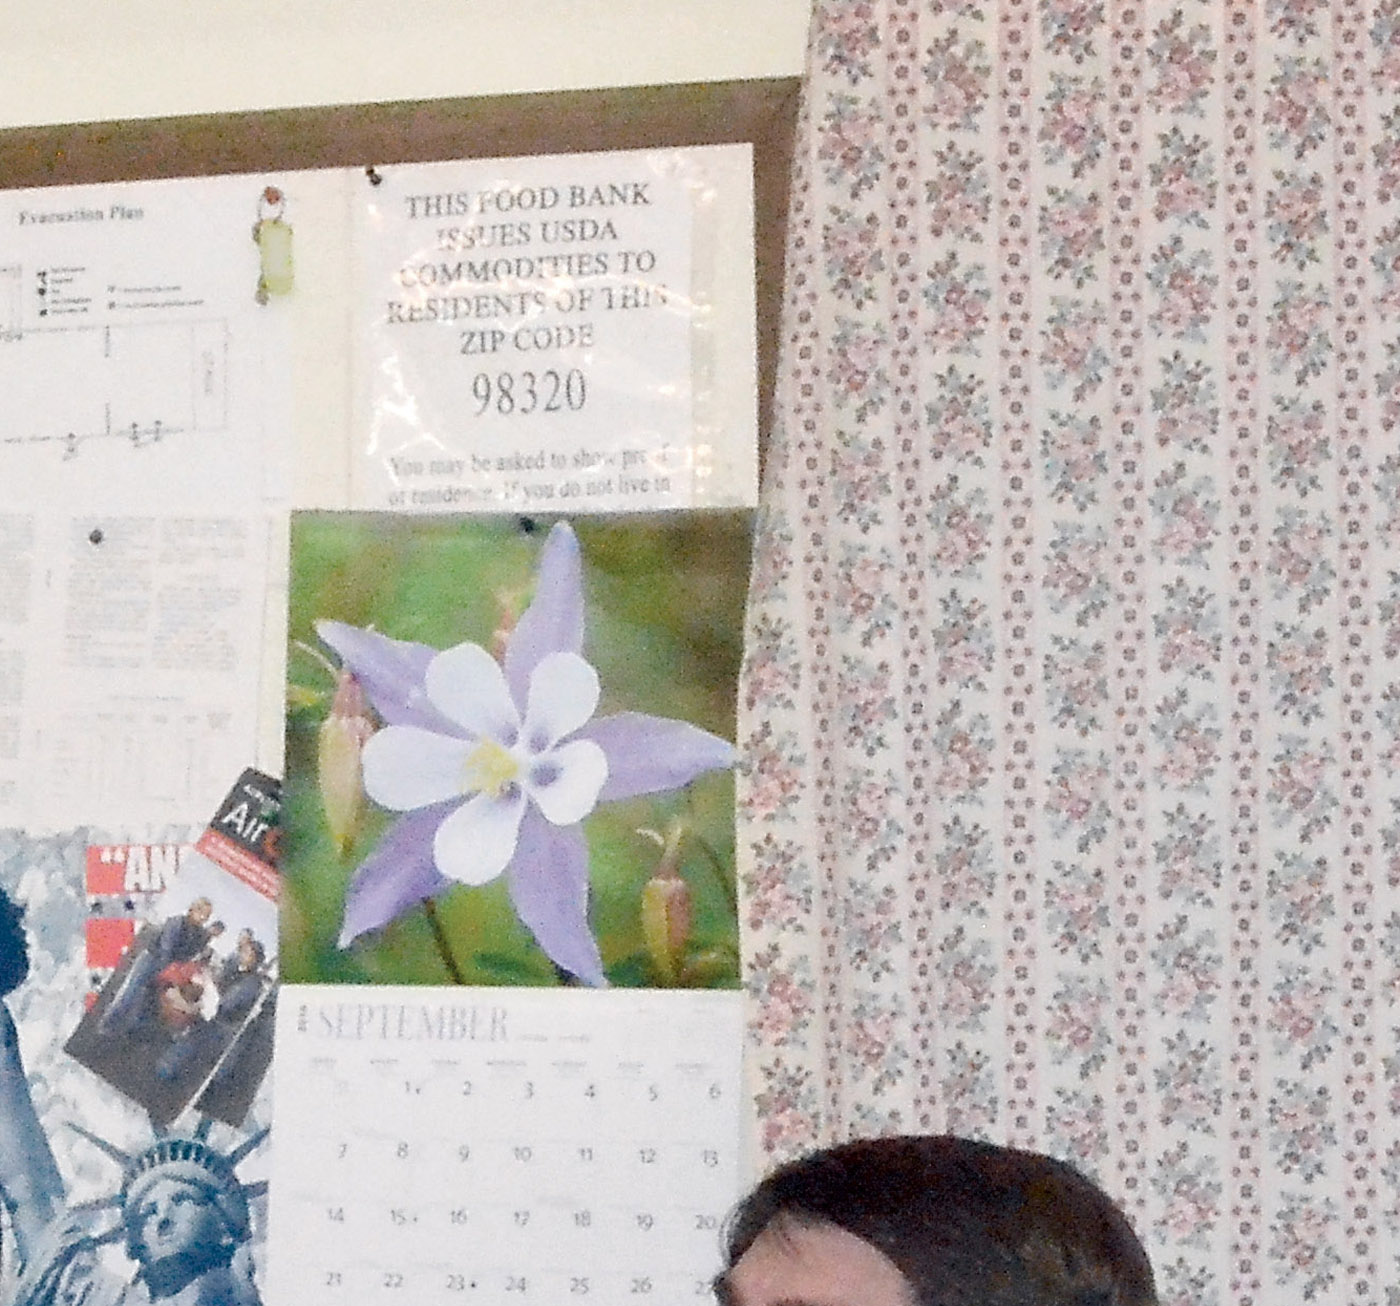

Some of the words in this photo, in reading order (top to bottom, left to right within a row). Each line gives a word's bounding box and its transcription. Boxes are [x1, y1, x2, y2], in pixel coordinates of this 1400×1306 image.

[18, 207, 104, 225] Evacuation
[110, 204, 145, 222] Plan
[405, 191, 468, 219] THIS
[477, 185, 560, 214] FOOD
[569, 182, 653, 208] BANK
[437, 222, 531, 251] ISSUES
[541, 218, 618, 244] USDA
[400, 250, 609, 288] COMMODITIES
[617, 249, 656, 274] TO
[387, 291, 546, 325] RESIDENTS
[555, 288, 597, 314] OF
[600, 284, 668, 312] THIS
[460, 330, 506, 356] ZIP
[514, 323, 596, 352] CODE
[472, 368, 587, 417] 98320
[471, 453, 491, 471] be
[496, 450, 545, 470] asked
[559, 481, 581, 499] do
[618, 474, 650, 496] live
[319, 1003, 509, 1041] SEPTEMBER
[405, 1081, 413, 1095] 1
[462, 1080, 473, 1096] 2
[525, 1081, 535, 1099] 3
[584, 1083, 597, 1099] 4
[709, 1083, 721, 1100] 6
[338, 1143, 348, 1159] 7
[396, 1141, 409, 1159] 8
[458, 1145, 470, 1162] 9
[512, 1146, 533, 1162] 10
[578, 1147, 594, 1161] 11
[638, 1148, 657, 1164] 12
[327, 1207, 345, 1223] 14
[390, 1209, 407, 1226] 15
[450, 1207, 468, 1224] 16
[573, 1209, 592, 1228] 18
[635, 1214, 655, 1232] 19
[696, 1214, 717, 1230] 20
[325, 1272, 342, 1286] 21
[383, 1273, 404, 1288] 22
[446, 1274, 465, 1292] 23
[505, 1275, 529, 1294] 24
[570, 1277, 590, 1295] 25
[630, 1276, 652, 1294] 26
